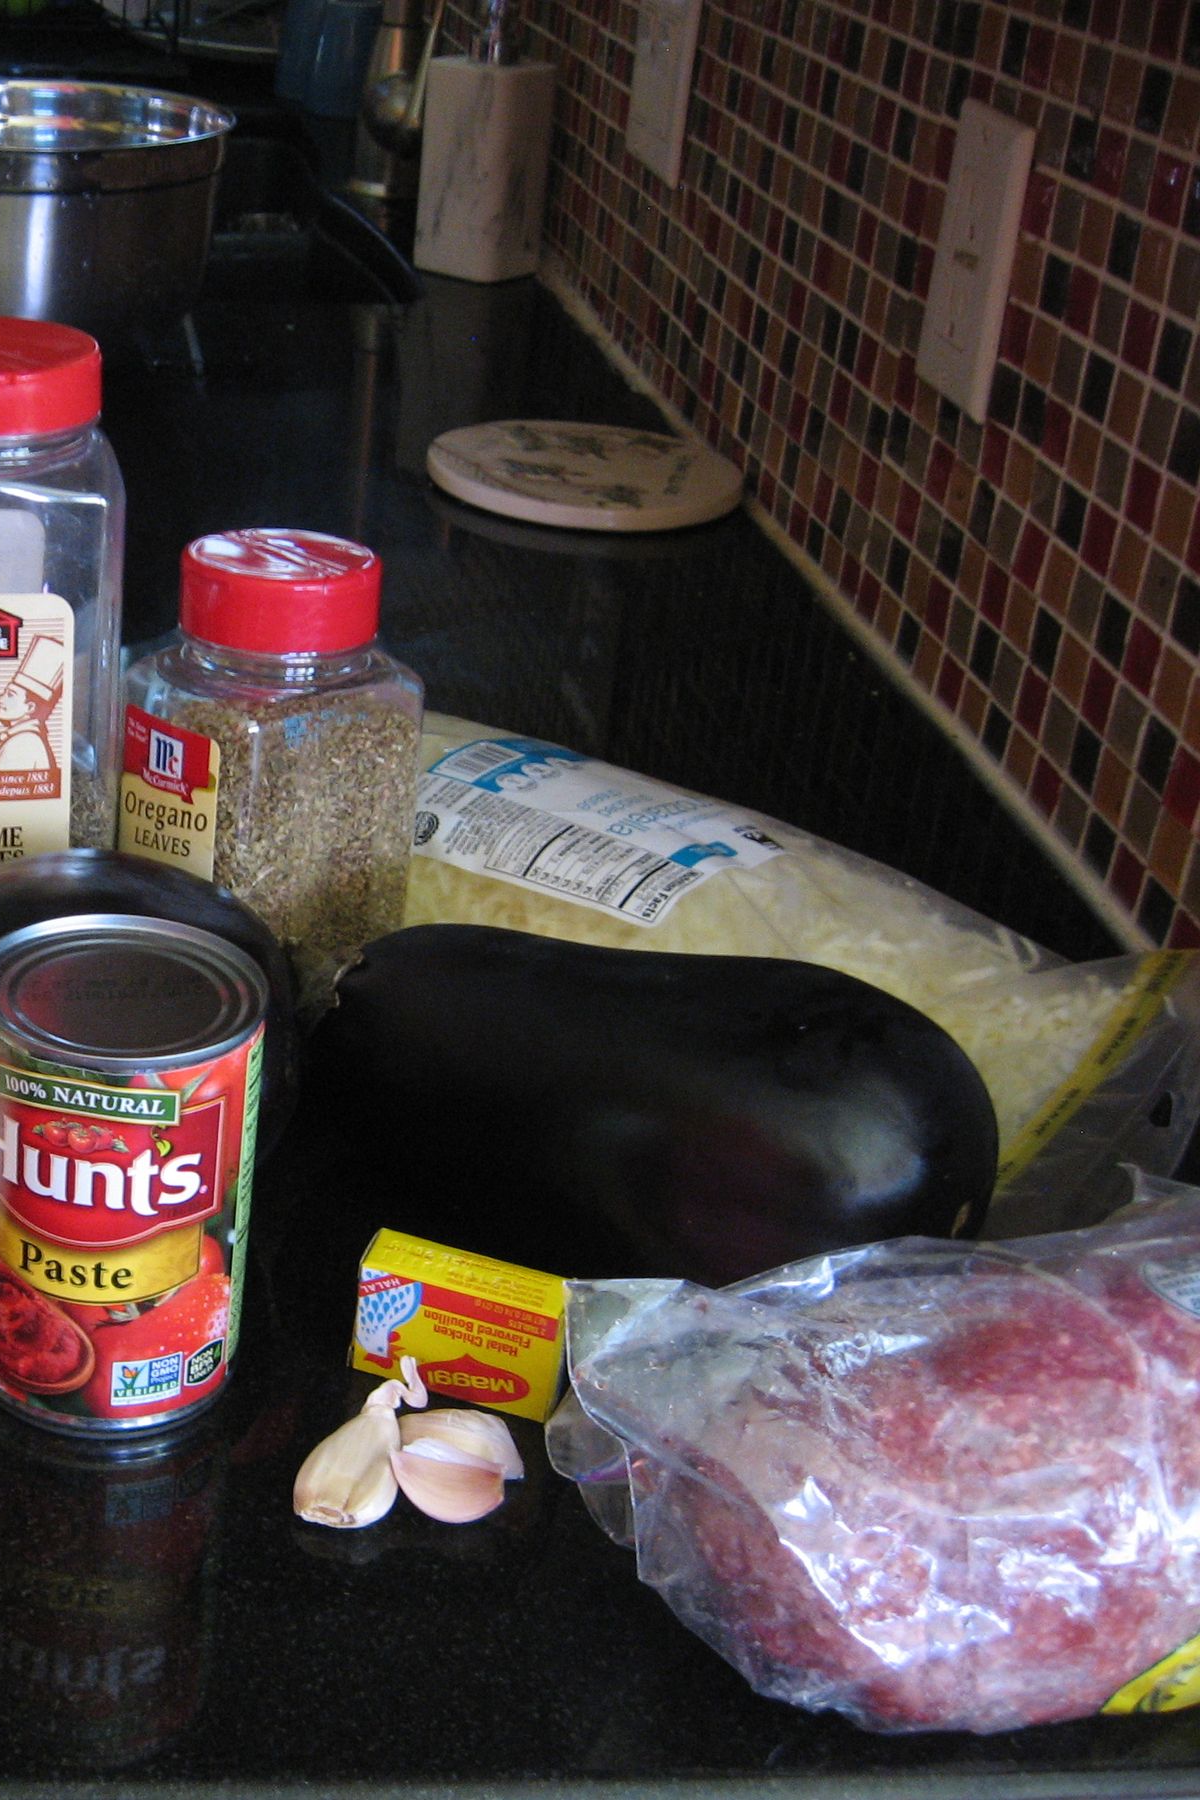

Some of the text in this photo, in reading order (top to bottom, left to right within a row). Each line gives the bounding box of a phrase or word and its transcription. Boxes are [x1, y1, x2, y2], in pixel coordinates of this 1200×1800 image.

[0, 774, 24, 784] since
[125, 790, 208, 832] Oregano
[134, 826, 191, 857] LEAVES
[4, 1073, 167, 1117] 100% NATURAL
[19, 1238, 134, 1290] Paste
[424, 1309, 532, 1348] Flavored Bouillon
[433, 1323, 519, 1357] Halal Chicken
[151, 1356, 179, 1370] NON
[190, 1356, 215, 1375] BPA
[191, 1347, 215, 1365] NON
[151, 1364, 179, 1378] GMO
[426, 1369, 517, 1395] Maggi
[115, 1380, 178, 1397] VERIFIED
